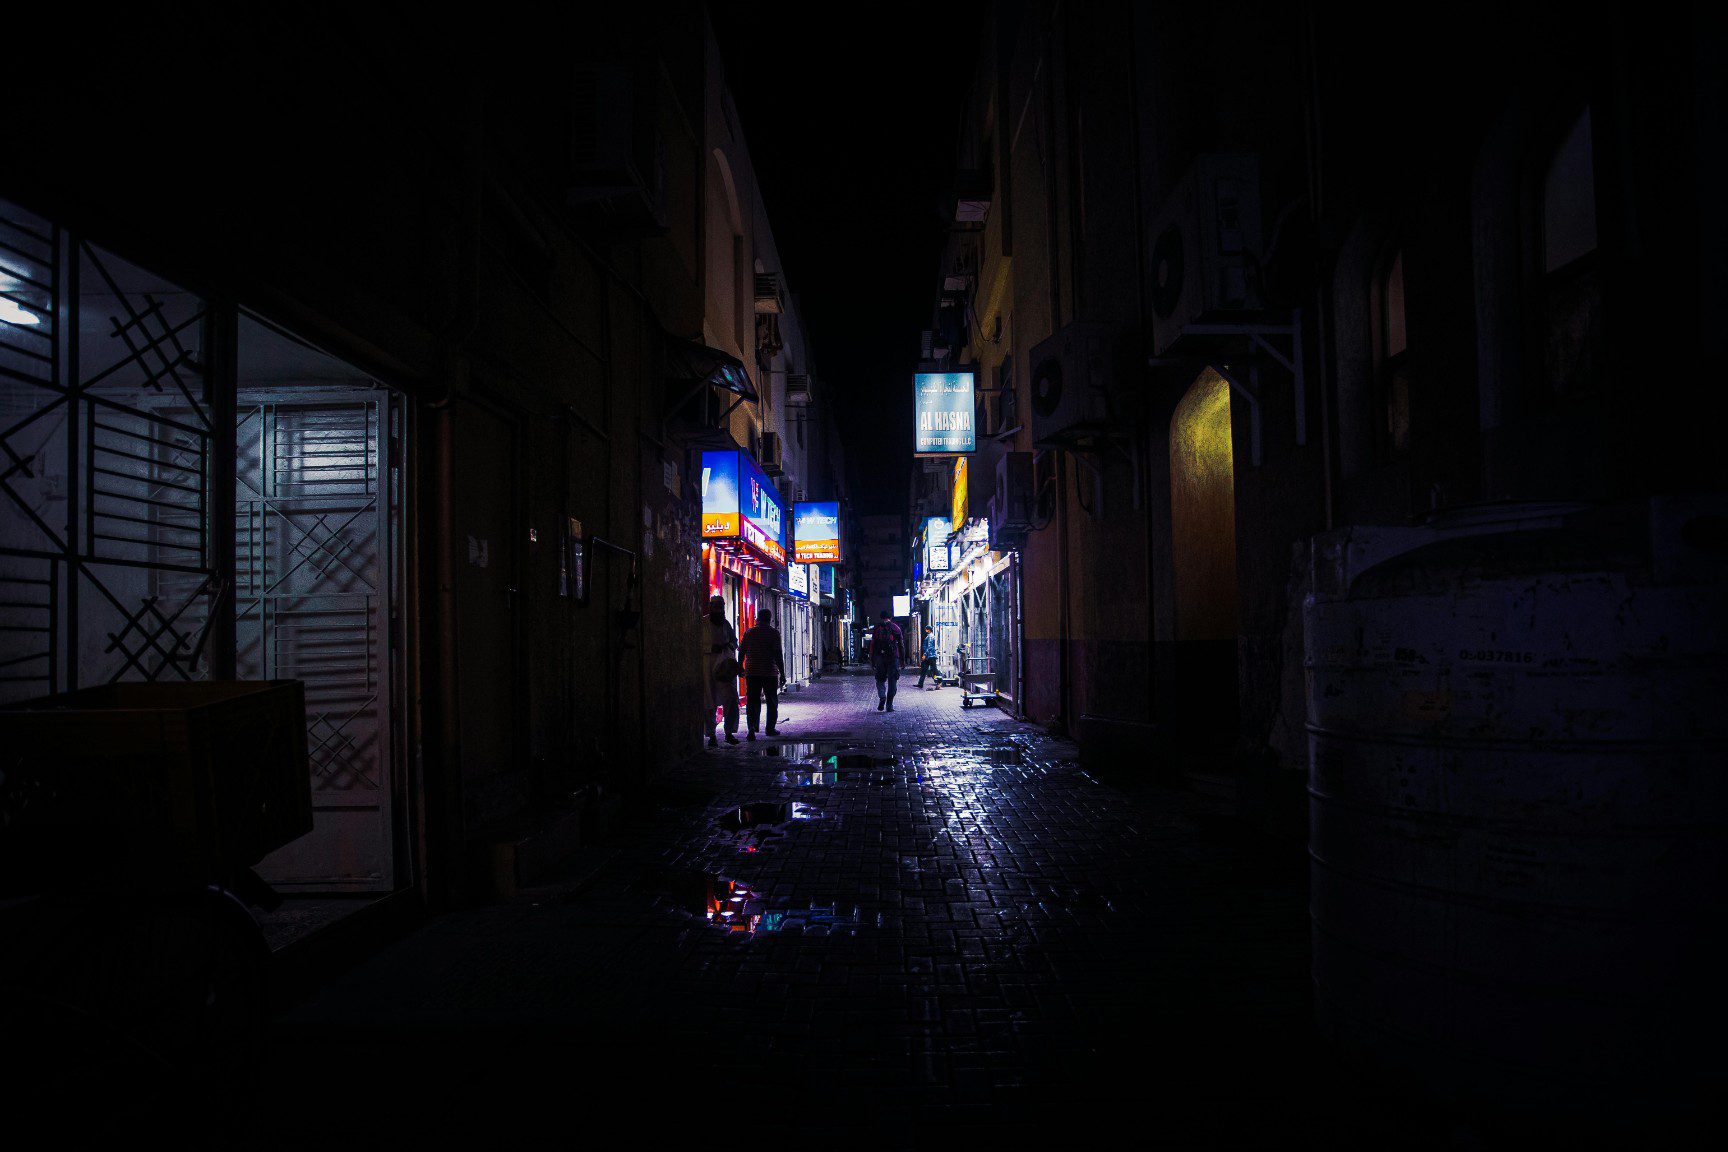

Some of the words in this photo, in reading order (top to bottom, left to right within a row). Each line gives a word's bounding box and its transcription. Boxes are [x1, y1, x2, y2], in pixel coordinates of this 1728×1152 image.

[920, 411, 933, 431] AL
[935, 411, 971, 431] HASNA
[704, 518, 730, 533] دبليو
[816, 516, 837, 525] TECH
